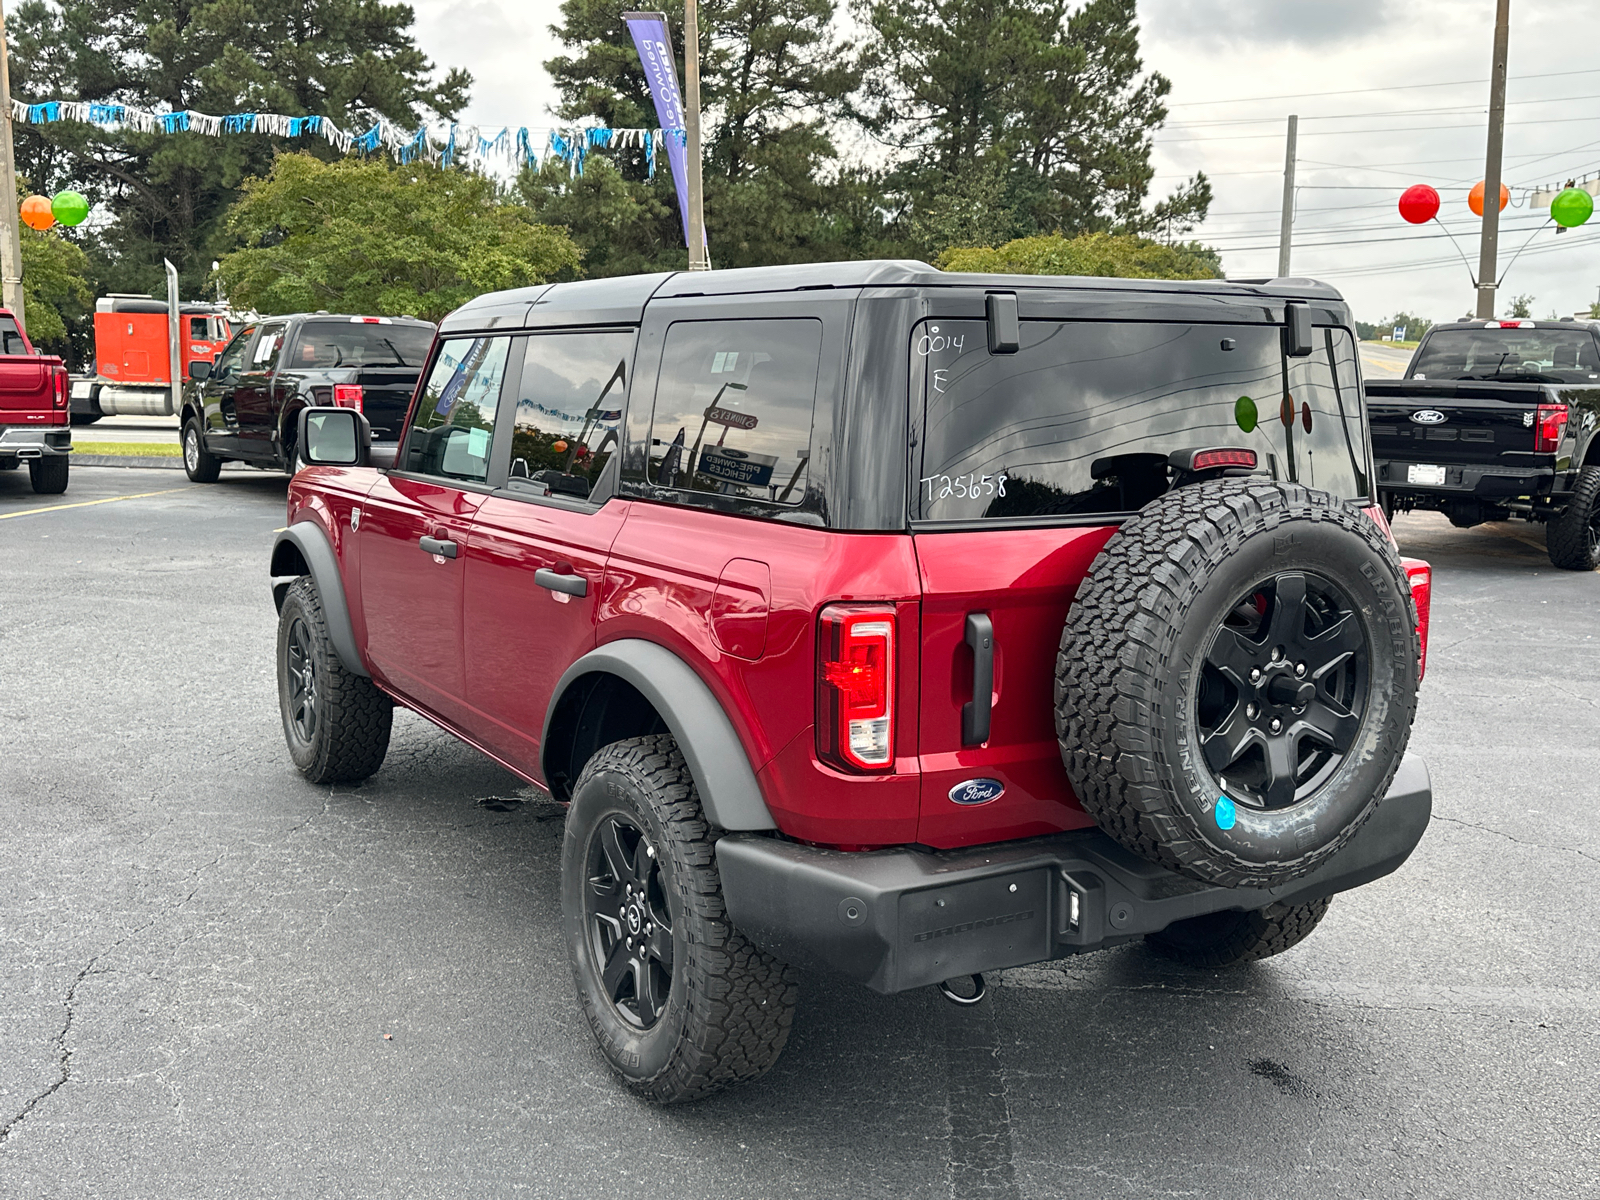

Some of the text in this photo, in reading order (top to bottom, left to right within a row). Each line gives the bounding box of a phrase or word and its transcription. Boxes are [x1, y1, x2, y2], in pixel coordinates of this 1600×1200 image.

[917, 334, 965, 356] 0014
[933, 368, 949, 393] E
[920, 473, 1007, 501] T25658
[1359, 560, 1407, 706] GRABBER
[1174, 652, 1213, 814] GENERAL
[961, 783, 994, 802] Ford
[913, 909, 1035, 943] BRONCO
